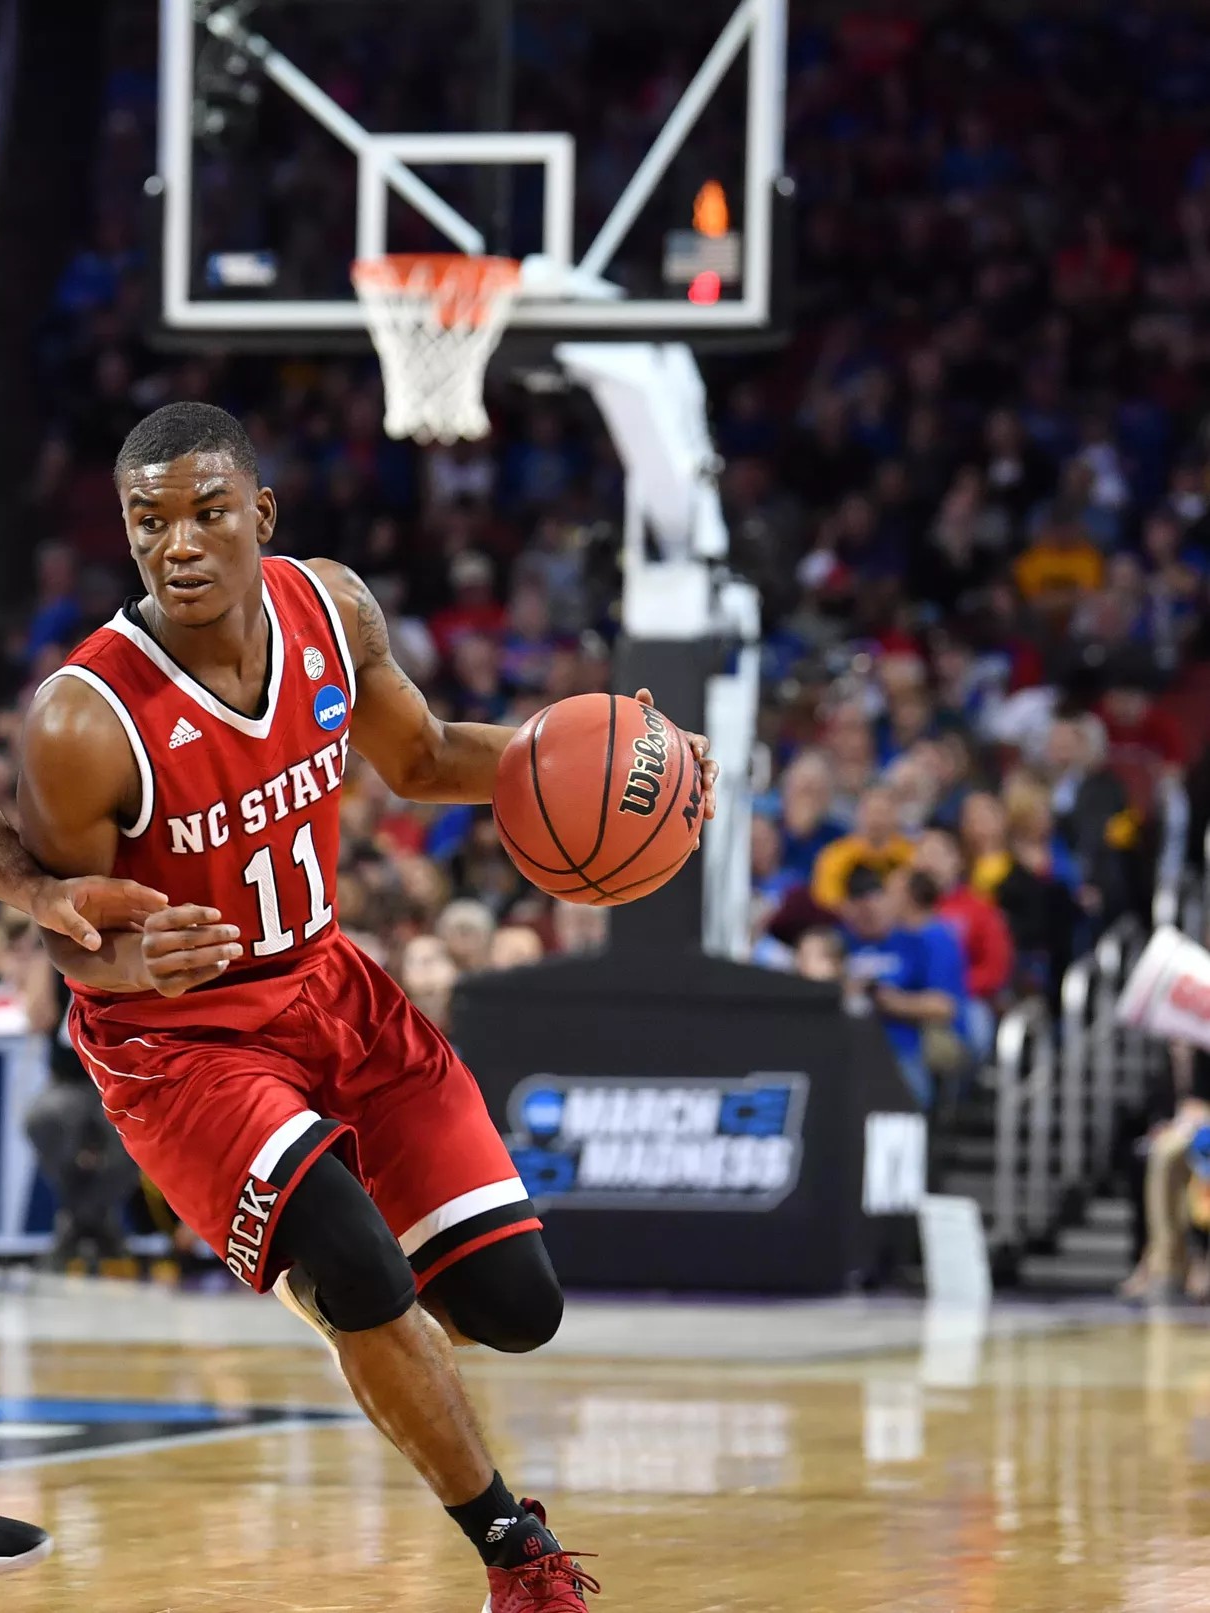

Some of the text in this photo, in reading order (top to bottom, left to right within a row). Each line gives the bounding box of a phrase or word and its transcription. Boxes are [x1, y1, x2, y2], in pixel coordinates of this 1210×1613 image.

[319, 702, 347, 722] NCAA
[168, 729, 203, 750] adidas
[167, 800, 230, 854] NC
[243, 822, 333, 957] 11
[226, 1178, 279, 1287] PACK
